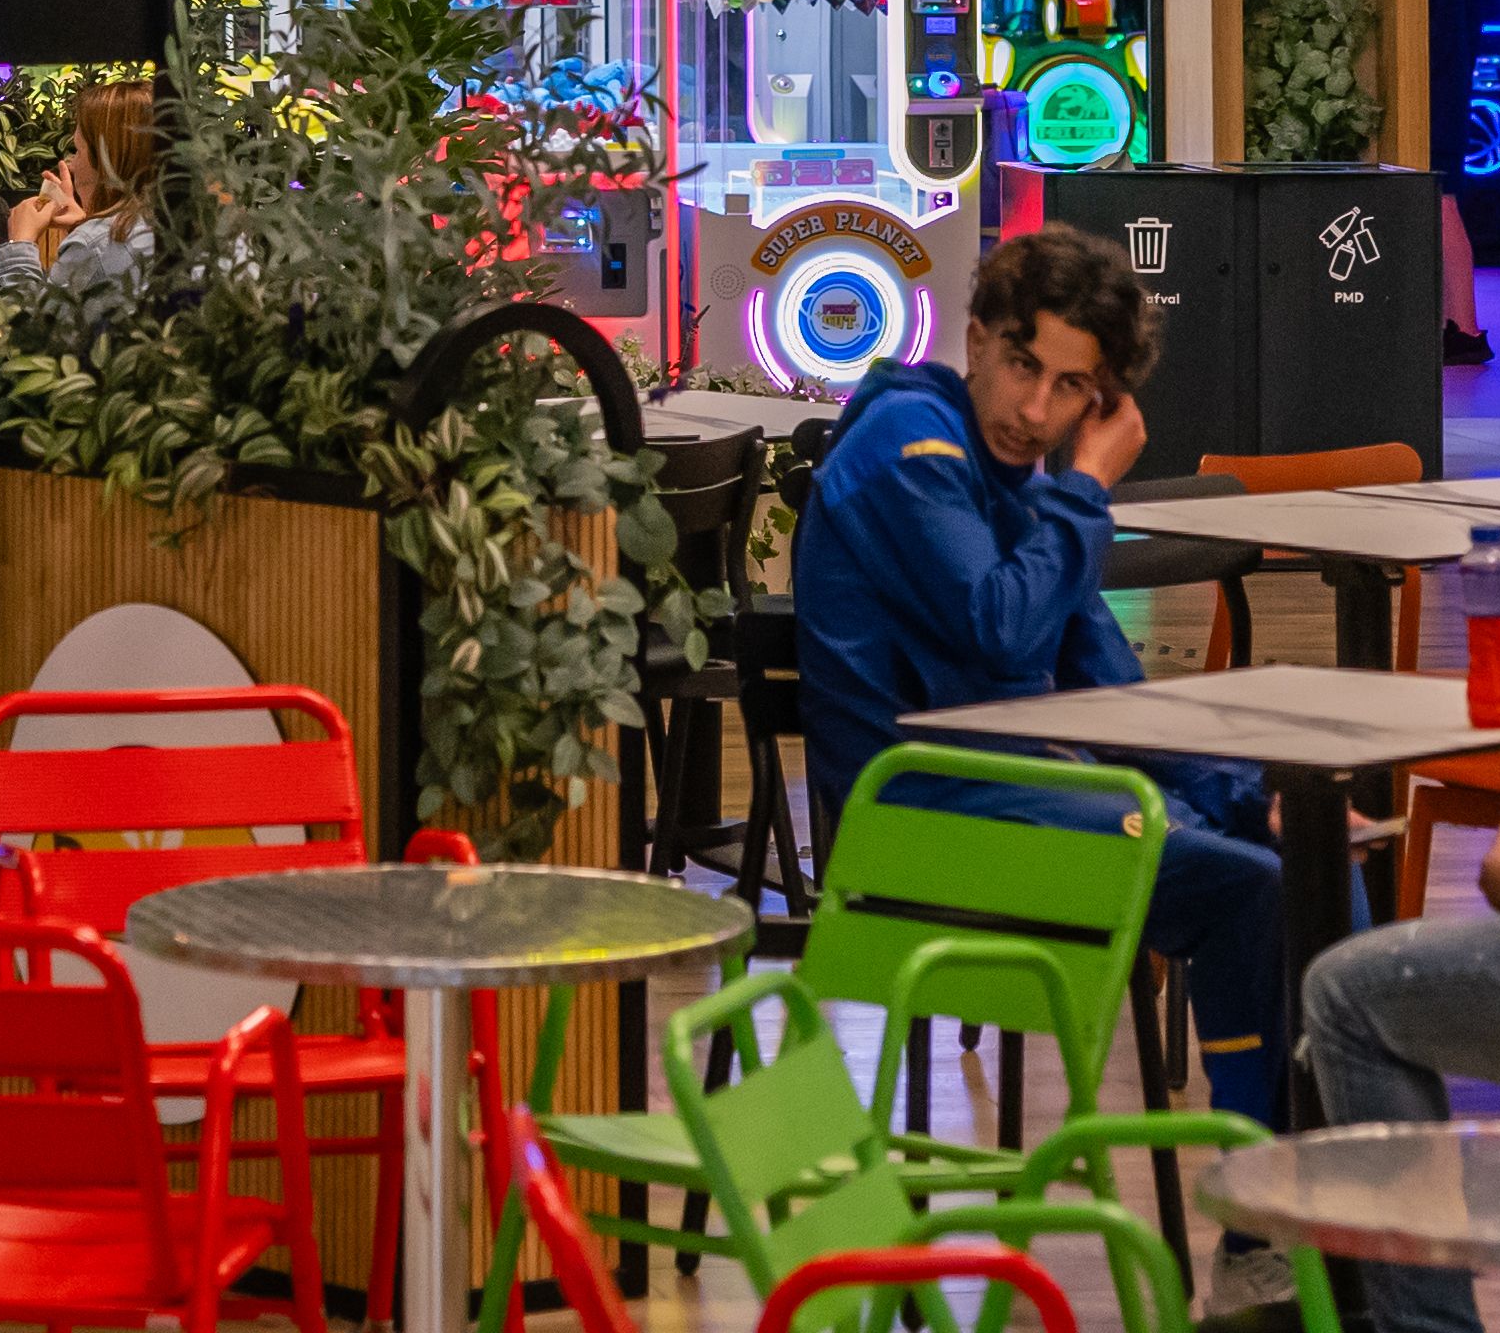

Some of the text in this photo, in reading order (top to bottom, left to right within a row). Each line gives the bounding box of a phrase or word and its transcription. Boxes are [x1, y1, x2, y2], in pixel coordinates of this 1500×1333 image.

[760, 211, 924, 268] SUPER PLANET
[1334, 291, 1364, 303] PMD
